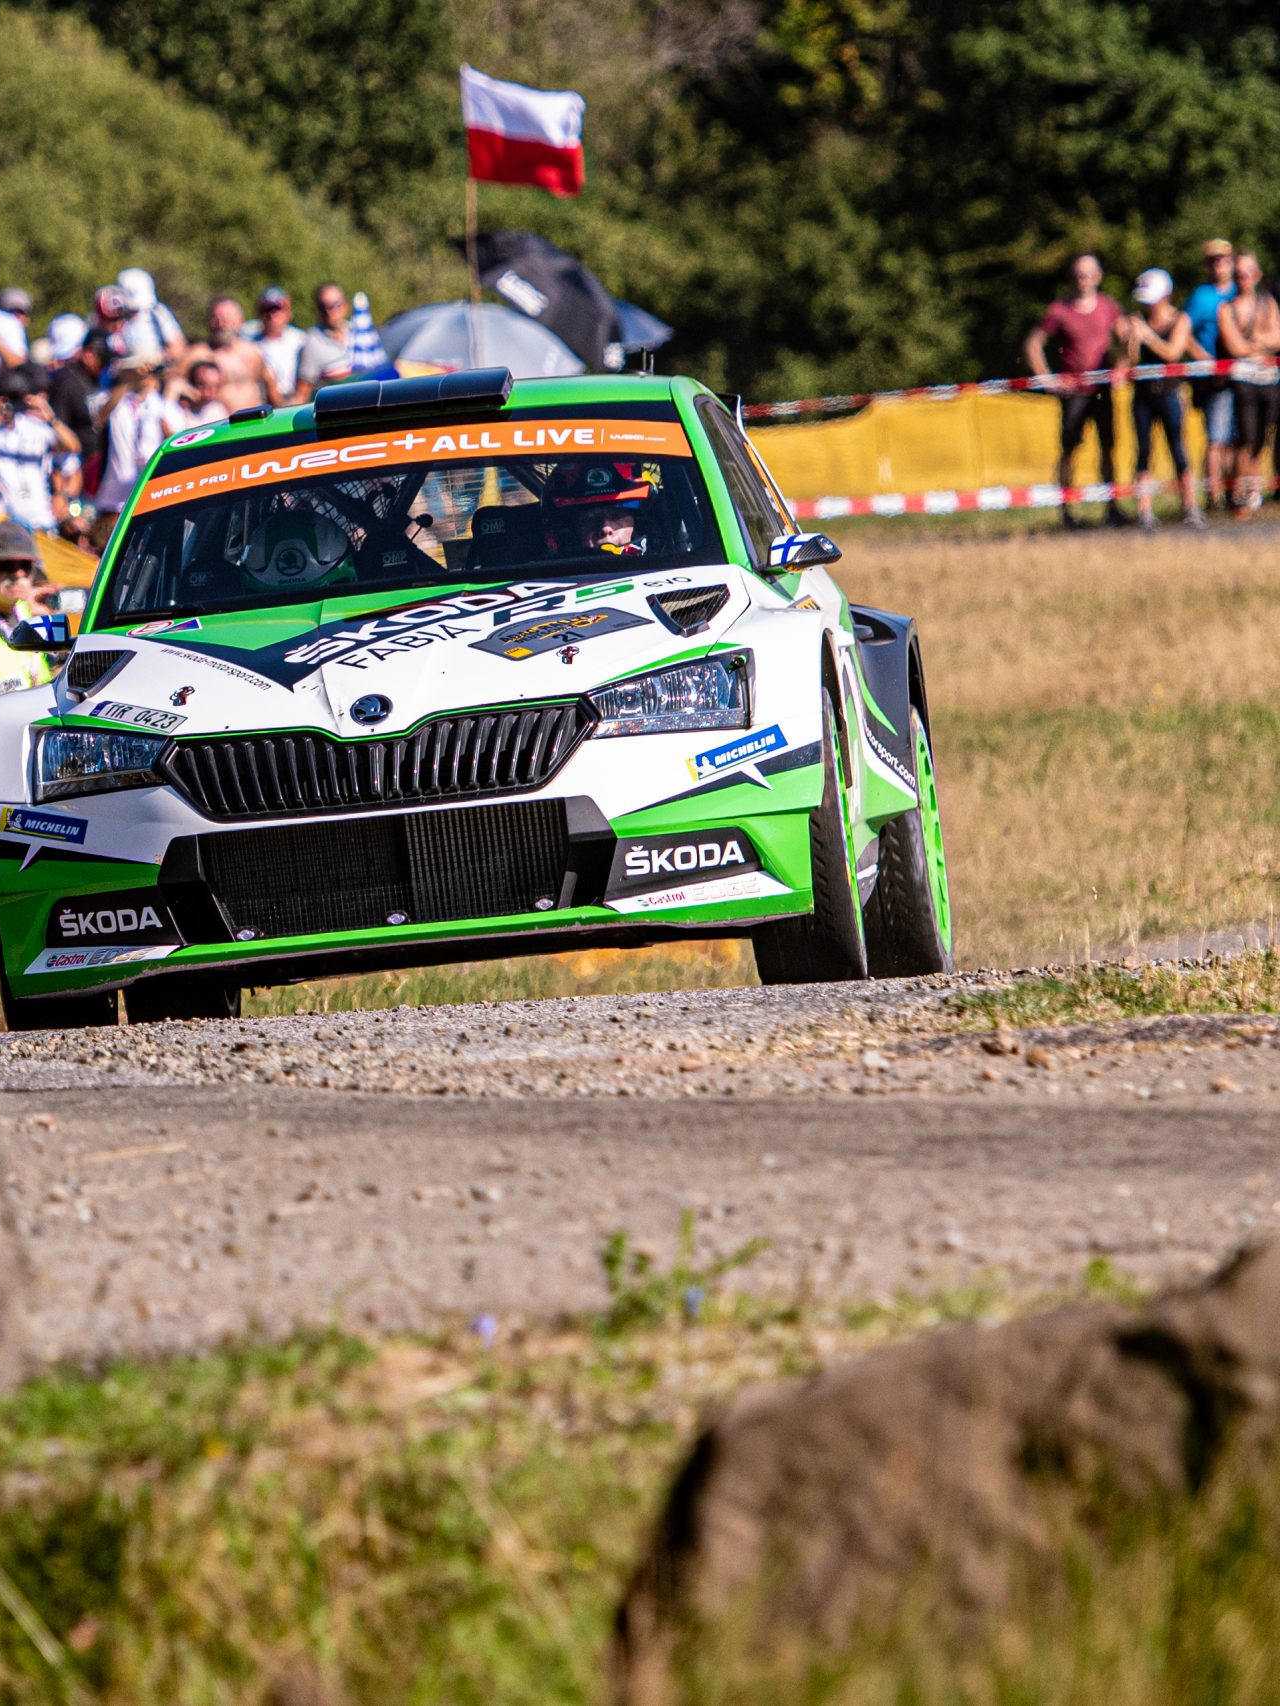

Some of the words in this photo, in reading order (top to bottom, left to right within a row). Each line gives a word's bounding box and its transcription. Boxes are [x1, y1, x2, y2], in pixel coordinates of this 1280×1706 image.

[431, 431, 501, 452] ALL
[513, 428, 595, 446] LIVE
[150, 483, 182, 499] WRC
[185, 480, 195, 490] 2
[199, 473, 228, 487] PRO
[382, 551, 408, 566] OMP
[336, 623, 480, 670] FABIA
[643, 576, 693, 588] evo
[552, 630, 585, 643] 21
[160, 647, 272, 691] www.skoda-motorsport.com
[133, 710, 178, 729] 0423
[714, 733, 777, 766] MICHELIN
[24, 818, 81, 836] MICHELIN
[624, 840, 746, 876] ŠKODA
[648, 890, 686, 906] Castrol
[59, 905, 164, 937] ŠKODA
[54, 952, 89, 967] Castrol
